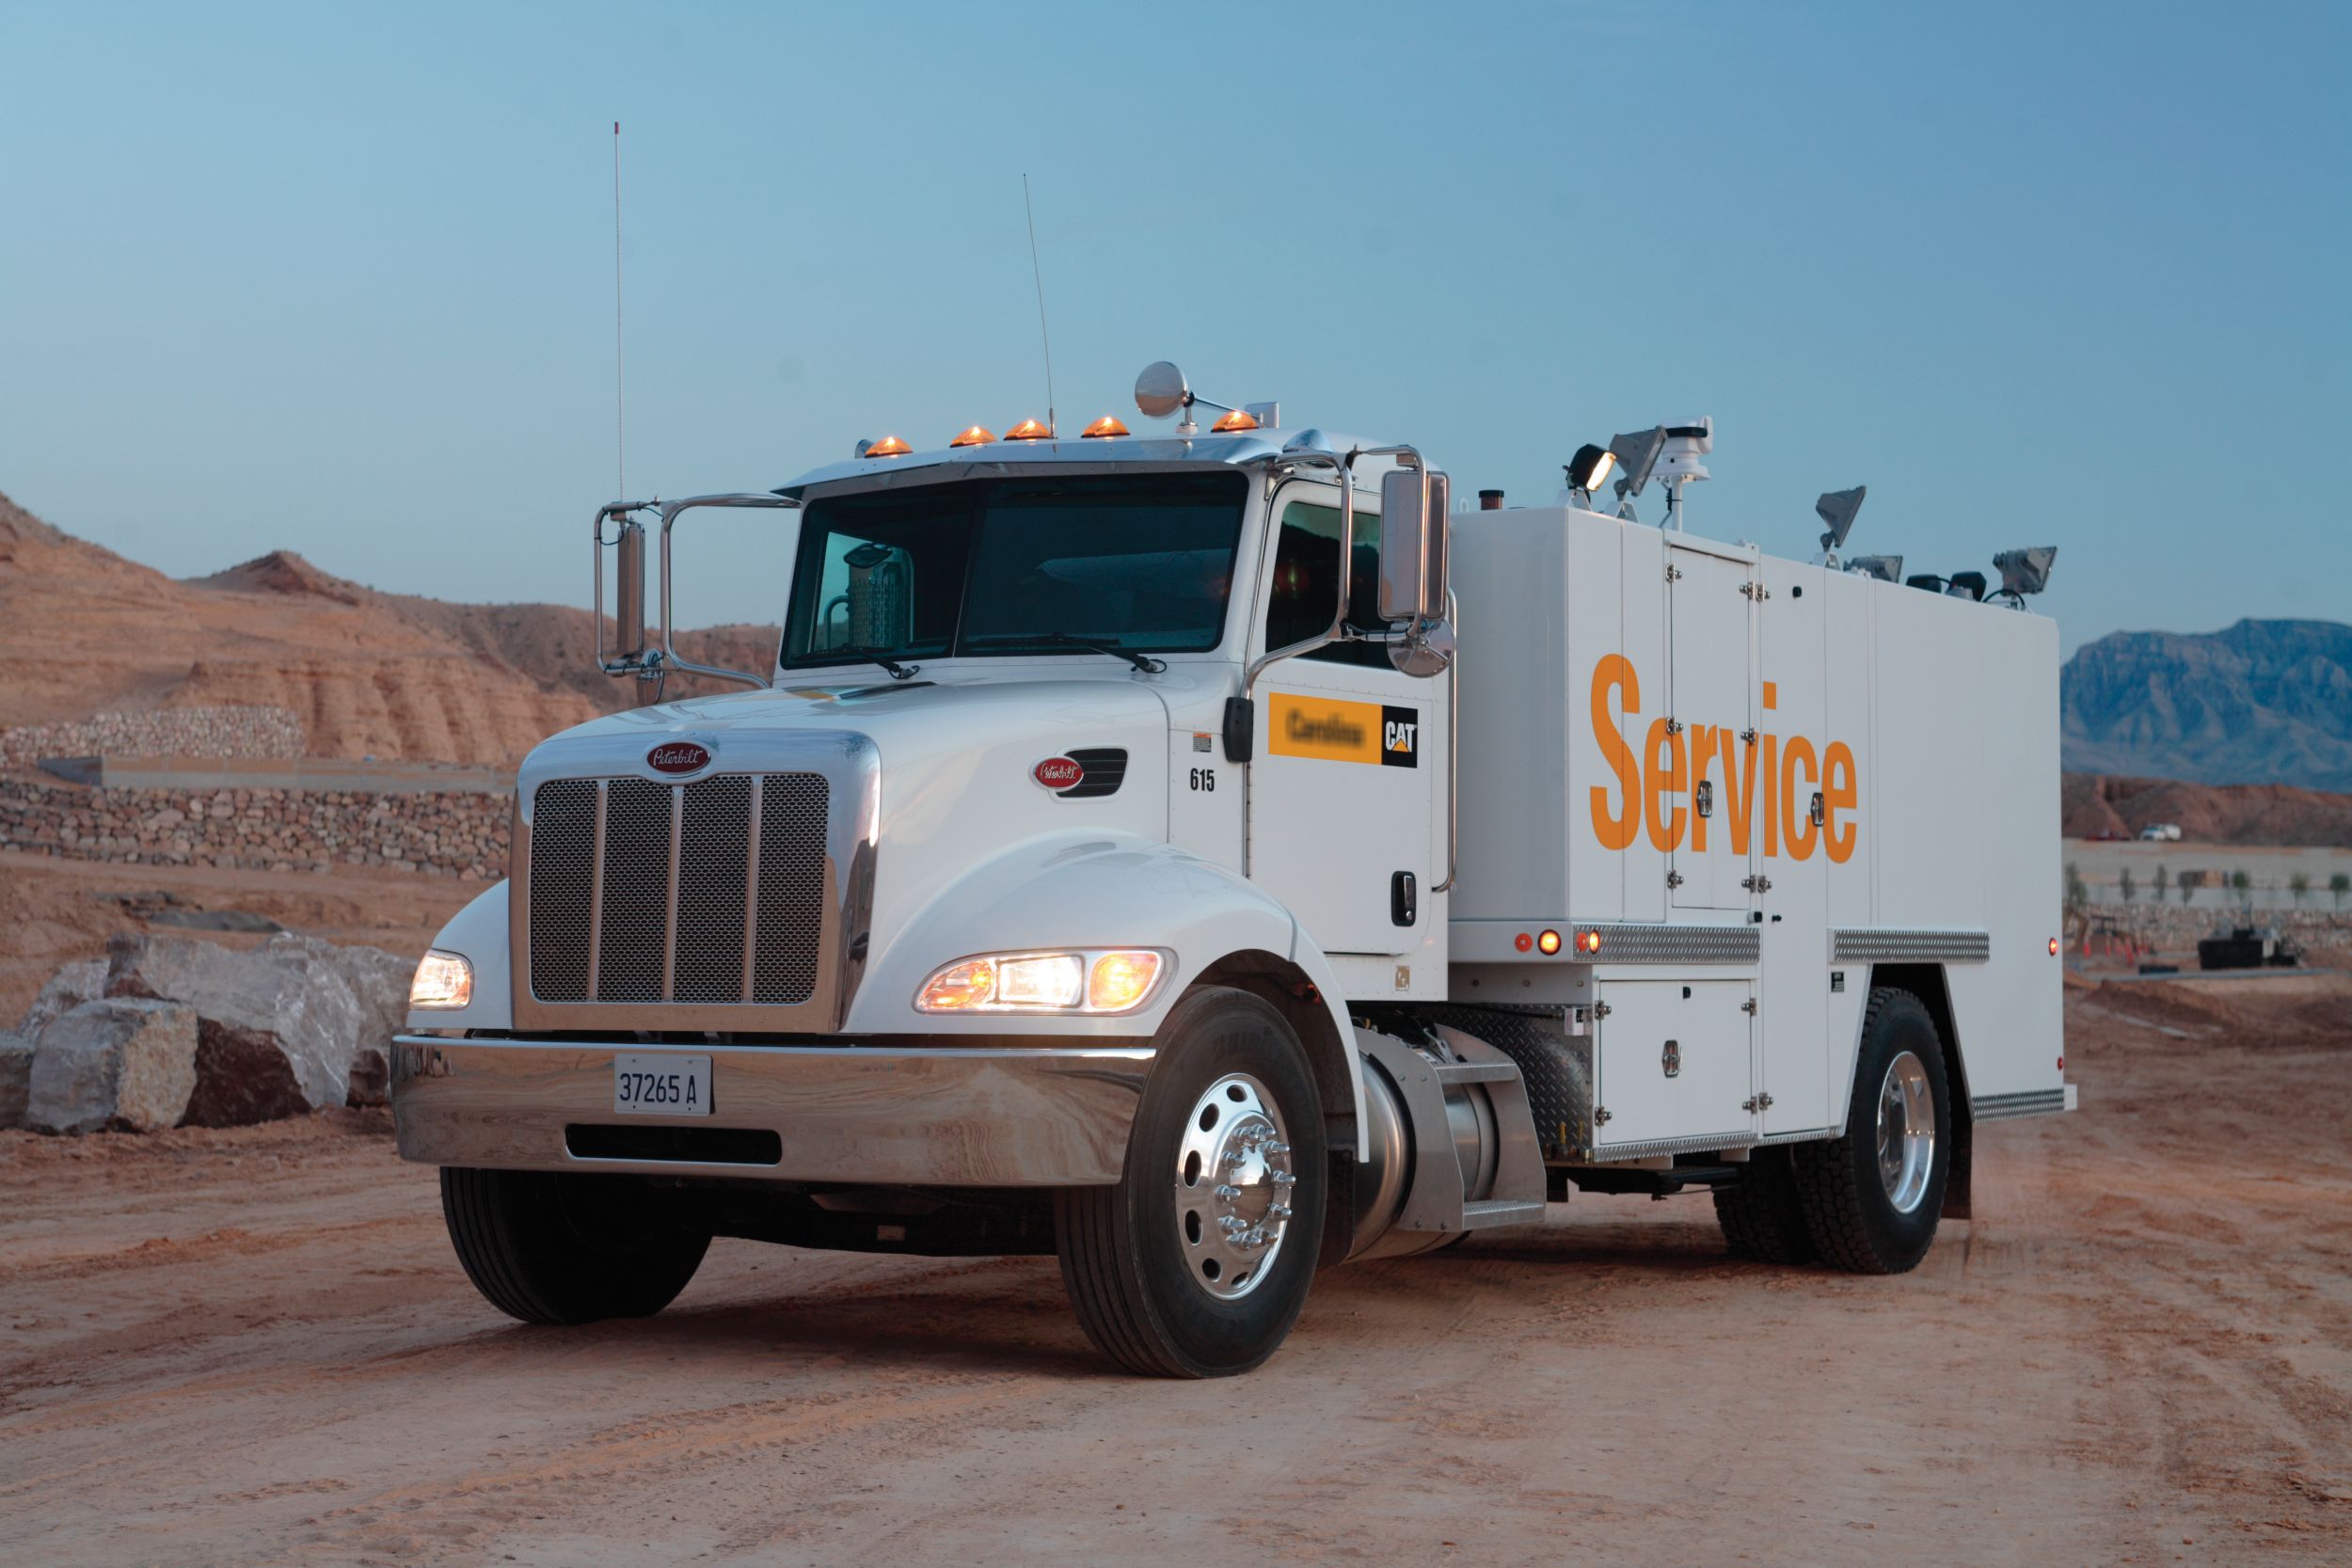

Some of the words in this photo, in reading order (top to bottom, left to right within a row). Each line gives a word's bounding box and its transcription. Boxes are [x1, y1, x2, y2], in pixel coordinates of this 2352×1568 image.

[1386, 721, 1415, 752] CAT
[653, 748, 703, 767] Peterbilt
[1590, 654, 1857, 864] Service
[1040, 763, 1078, 780] Peterbilt
[1190, 768, 1215, 792] 615
[619, 1073, 680, 1103] 37265
[686, 1075, 696, 1104] A
